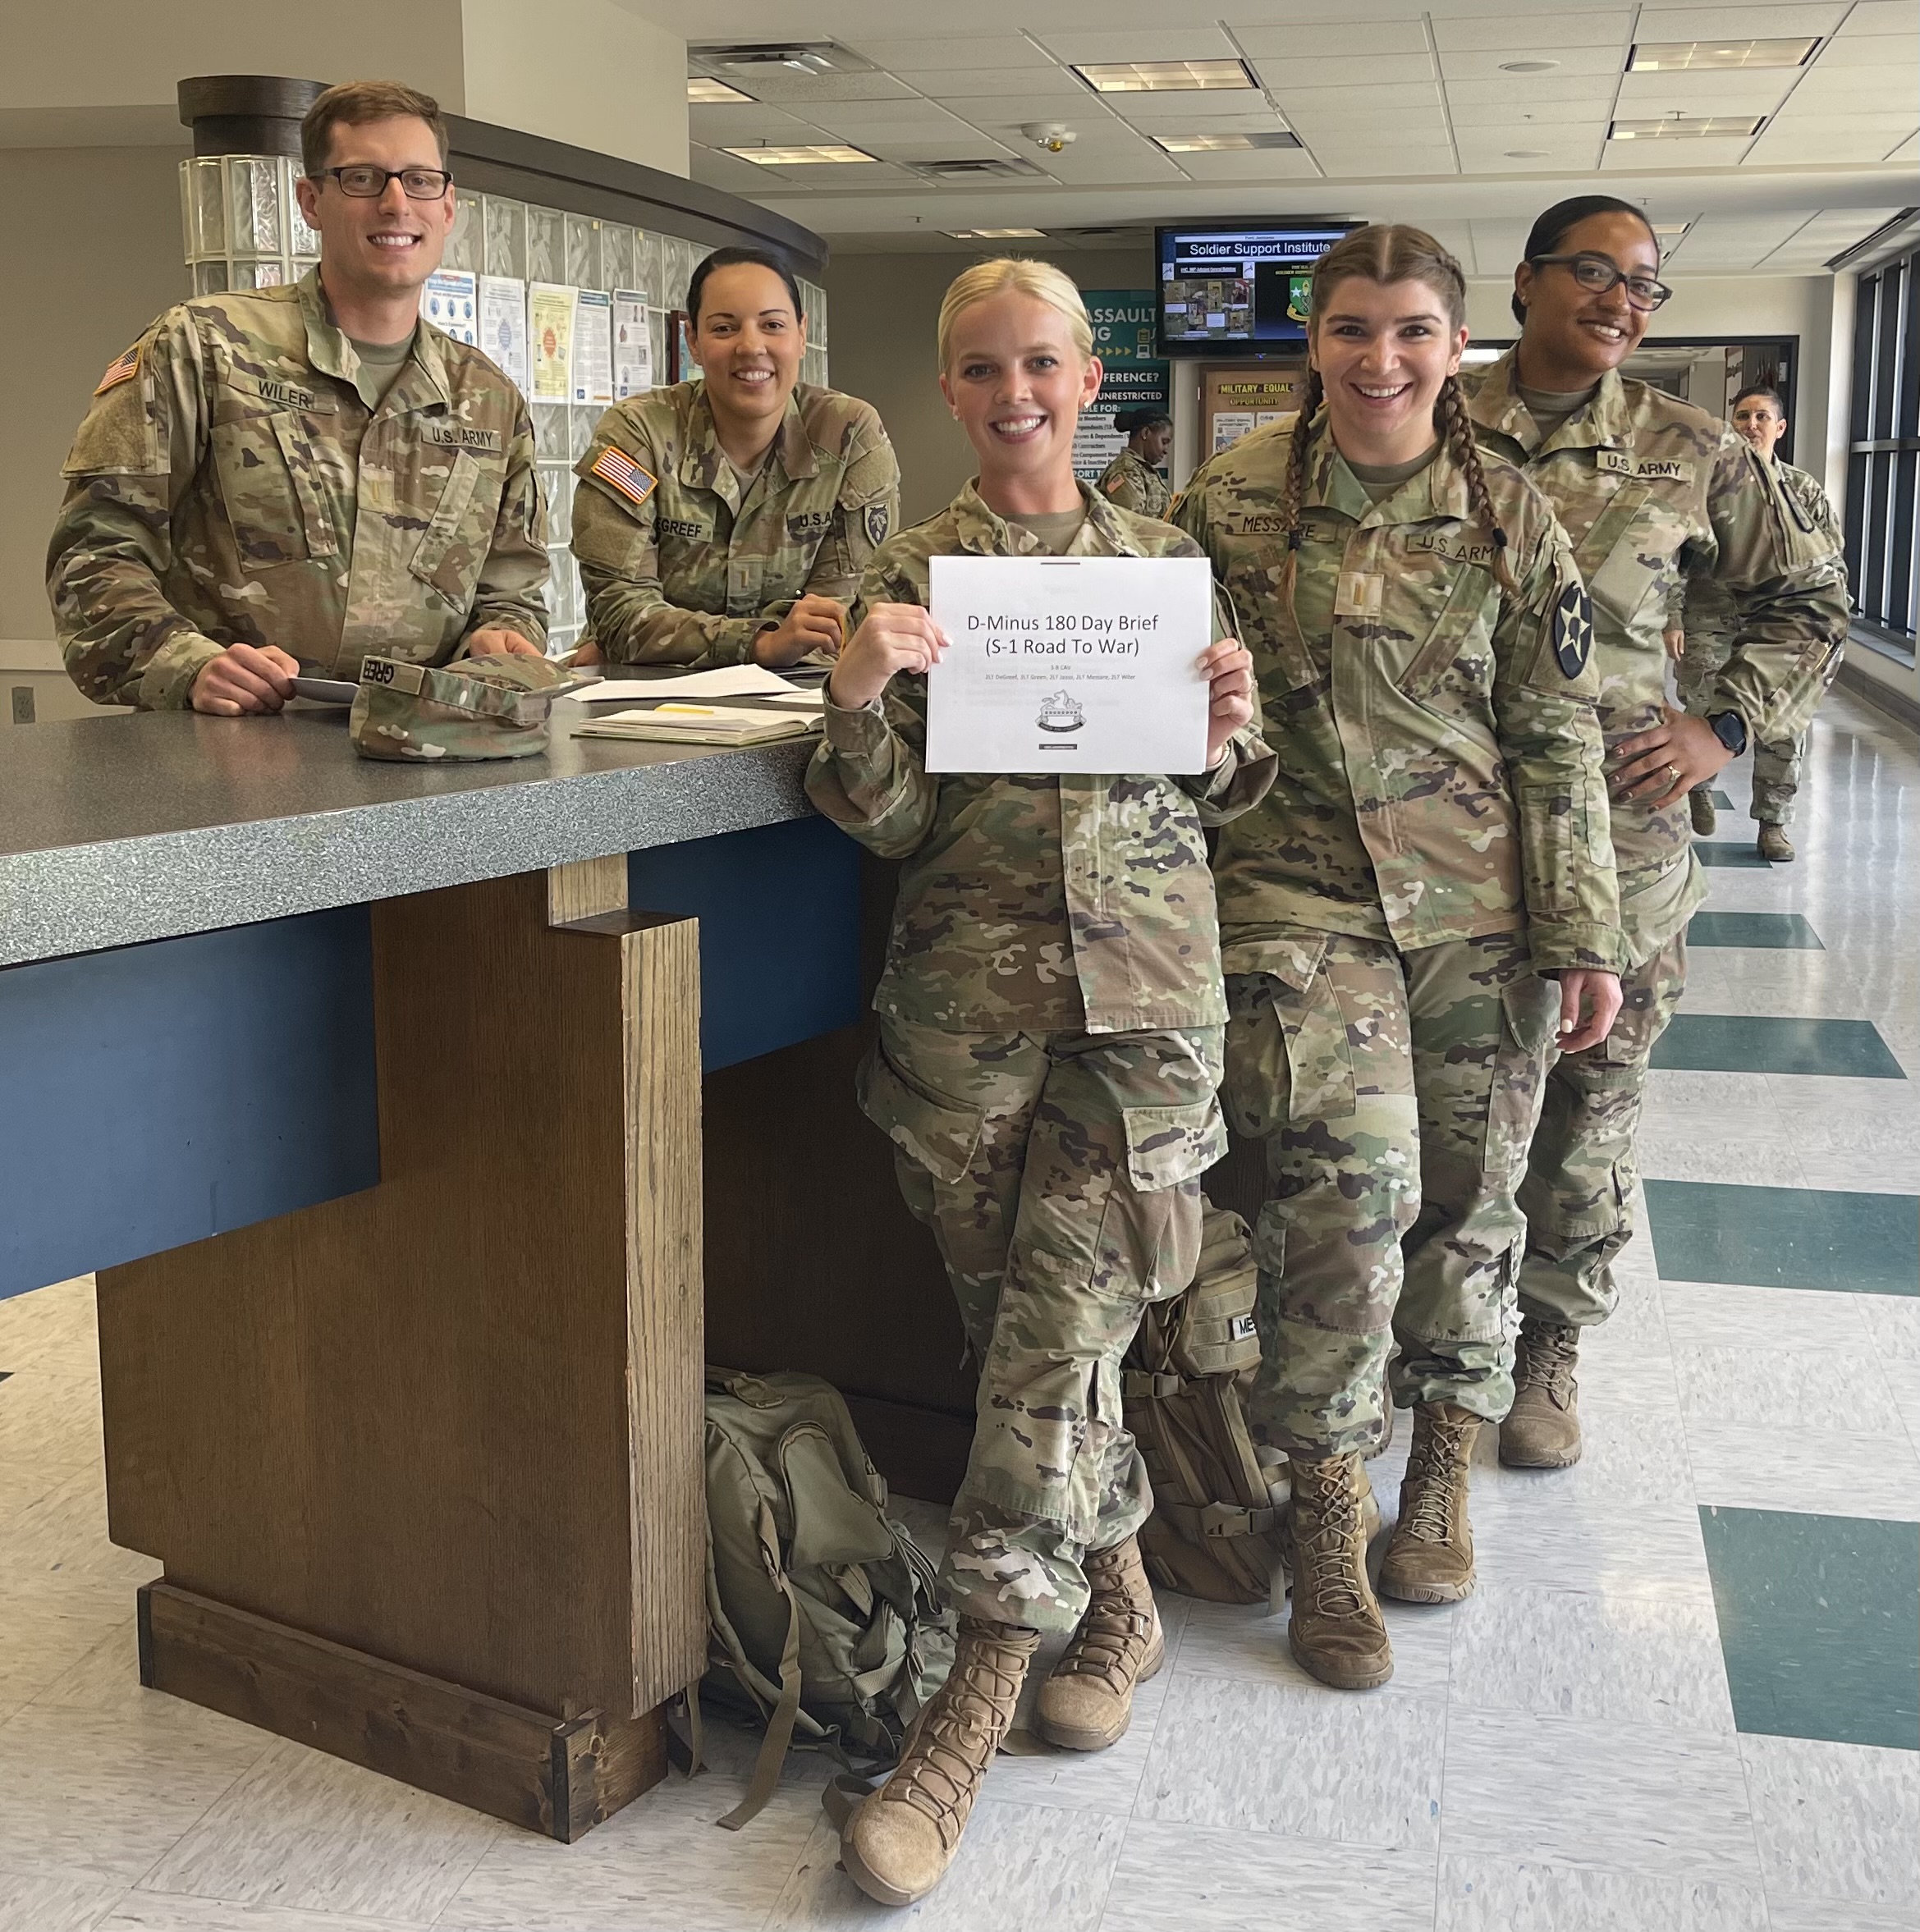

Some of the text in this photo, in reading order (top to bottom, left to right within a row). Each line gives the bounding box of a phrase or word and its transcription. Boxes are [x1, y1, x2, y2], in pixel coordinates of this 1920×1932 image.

[1189, 241, 1331, 257] Soldier Support Institute
[259, 380, 310, 409] WILER
[1097, 391, 1162, 401] UNRESTRICTED
[1221, 383, 1291, 394] MILITARY EQUAL
[1100, 404, 1121, 413] FOR:
[432, 427, 493, 447] U.S. ARMY
[1607, 454, 1681, 476] U.S. ARMY
[1455, 545, 1495, 561] ARM
[967, 614, 1159, 634] D-Minus 180 Day Brief
[985, 638, 1139, 657] (S-1 Road To War)
